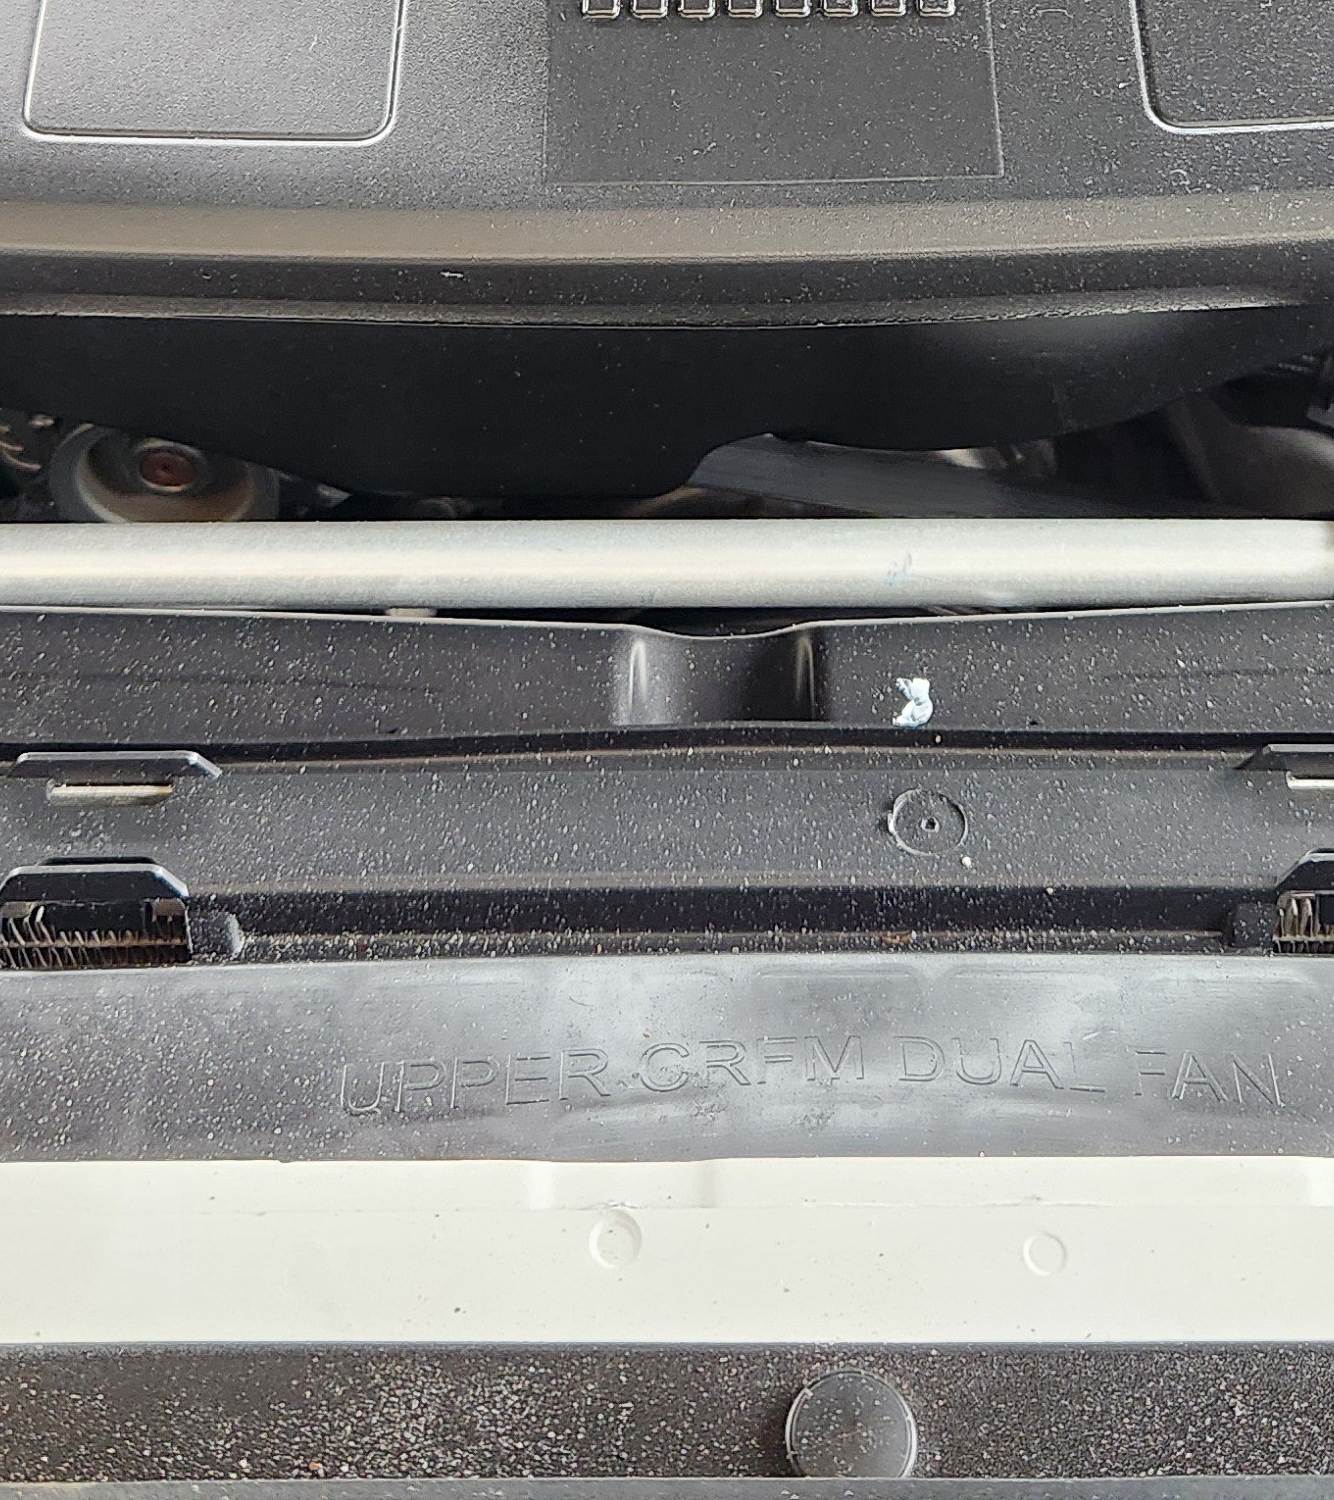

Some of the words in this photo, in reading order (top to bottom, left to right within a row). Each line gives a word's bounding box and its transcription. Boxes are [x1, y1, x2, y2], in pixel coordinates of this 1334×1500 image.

[339, 1047, 611, 1117] UPPER
[638, 1034, 866, 1093] CRFM
[899, 1034, 1105, 1093] DUAL
[1133, 1048, 1281, 1107] FAN
